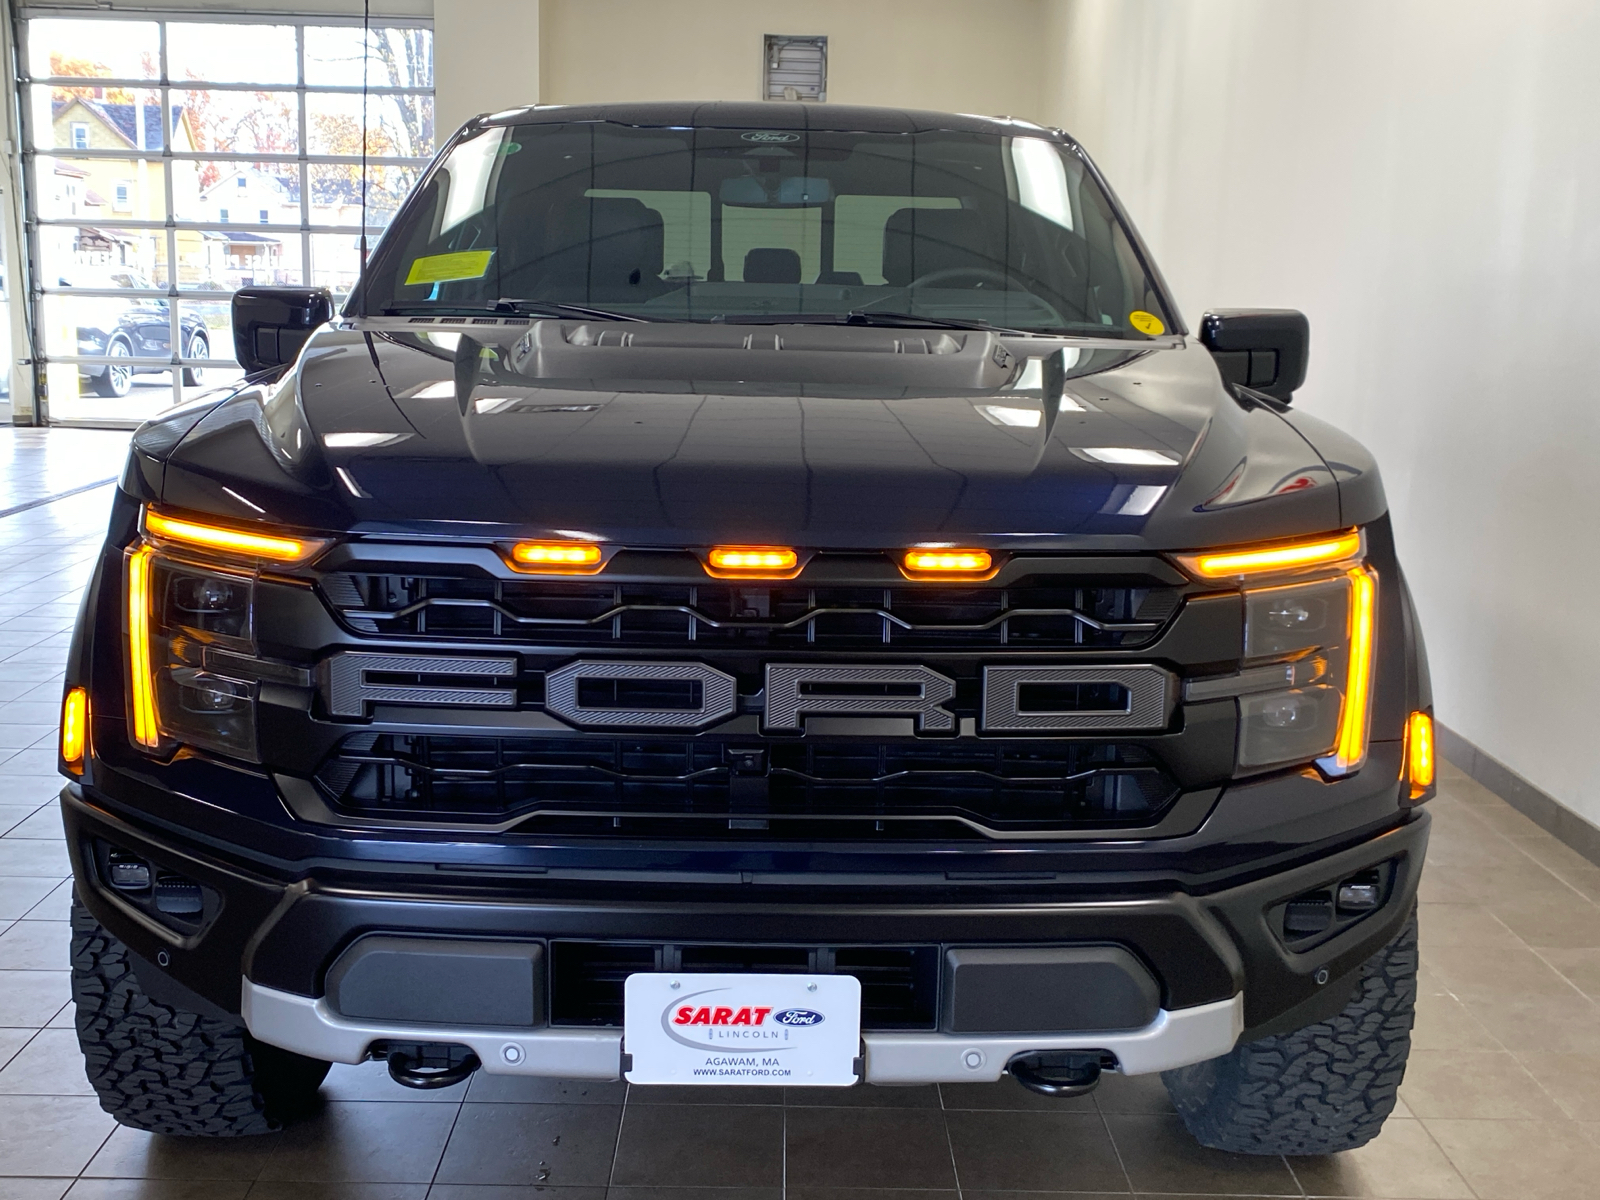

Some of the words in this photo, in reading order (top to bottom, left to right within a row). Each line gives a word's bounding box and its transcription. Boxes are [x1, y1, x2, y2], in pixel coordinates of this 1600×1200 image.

[750, 131, 791, 142] Ford
[330, 651, 1171, 731] FORD
[673, 1005, 774, 1026] SARAT
[782, 1010, 817, 1024] Ford
[718, 1030, 779, 1039] LINCOLN
[705, 1057, 759, 1067] AGAWAM,
[762, 1058, 780, 1067] MA
[693, 1068, 791, 1077] WWW.SARATFORD.COM
